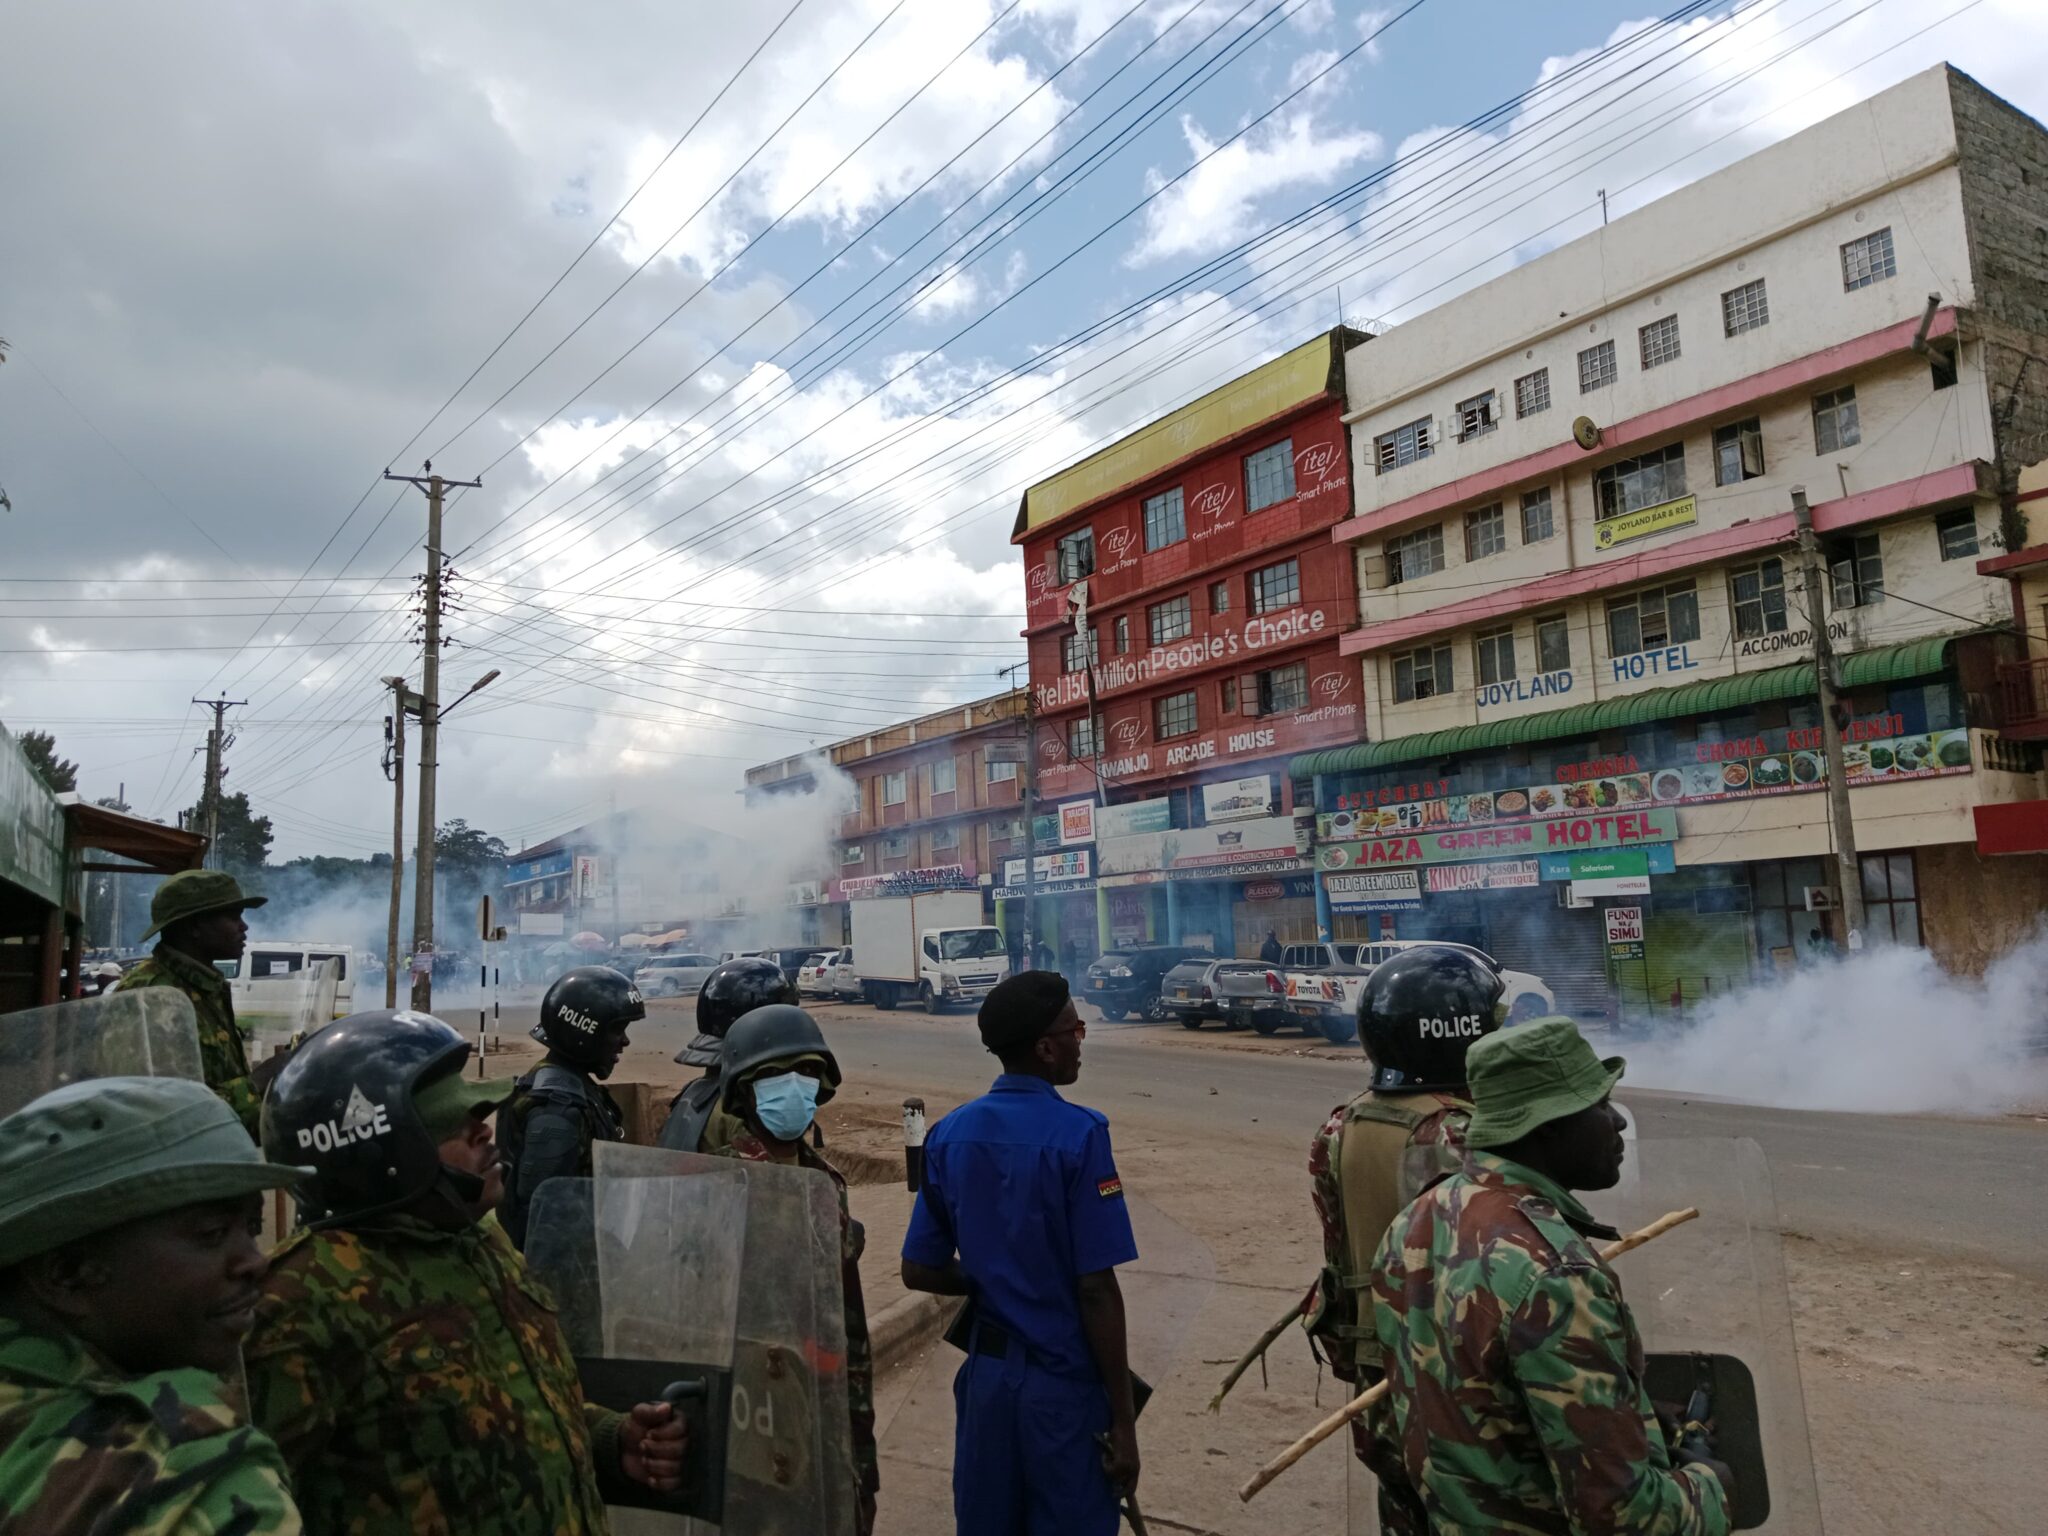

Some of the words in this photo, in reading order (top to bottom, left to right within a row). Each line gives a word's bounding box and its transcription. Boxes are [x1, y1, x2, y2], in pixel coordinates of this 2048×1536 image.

[1304, 445, 1333, 471] itel
[1202, 486, 1226, 511] itel
[1296, 487, 1321, 502] Smart
[1323, 477, 1346, 492] Phone
[1617, 516, 1650, 531] JOYLAND
[1652, 512, 1666, 521] BAR
[1676, 504, 1693, 514] REST
[1109, 529, 1129, 550] itel
[1095, 657, 1149, 694] Million
[1151, 628, 1239, 677] People's
[1244, 609, 1325, 648] Choice
[1613, 645, 1698, 682] HOTEL
[1321, 674, 1343, 691] itel
[1476, 671, 1573, 707] JOYLAND
[1294, 709, 1323, 725] Smart
[1325, 703, 1357, 719] Phone
[1119, 720, 1140, 738] itel
[1045, 742, 1060, 753] itel
[1166, 740, 1215, 766] ARCADE
[1228, 729, 1275, 753] HOUSE
[1696, 736, 1768, 763] CHOMA
[1036, 769, 1056, 779] Smart
[1056, 764, 1077, 774] Phone
[1557, 754, 1639, 782] CHEMSHA
[1337, 779, 1449, 810] BUTCHERY
[1355, 838, 1423, 866] JAZA
[1437, 824, 1532, 851] GREEN
[1547, 812, 1663, 846] HOTEL
[1487, 863, 1518, 876] Season
[1521, 861, 1538, 873] Two
[1581, 865, 1614, 873] Safaricom
[995, 883, 1044, 898] HARDWRE
[1330, 877, 1352, 893] JAZA
[1352, 875, 1384, 892] GREEN
[1384, 873, 1416, 889] HOTEL
[1607, 910, 1639, 920] FUNDI
[1610, 928, 1640, 940] SIMU
[1297, 986, 1321, 995] TOYOTA
[558, 1005, 598, 1034] POLICE
[1419, 1015, 1482, 1038] POLICE
